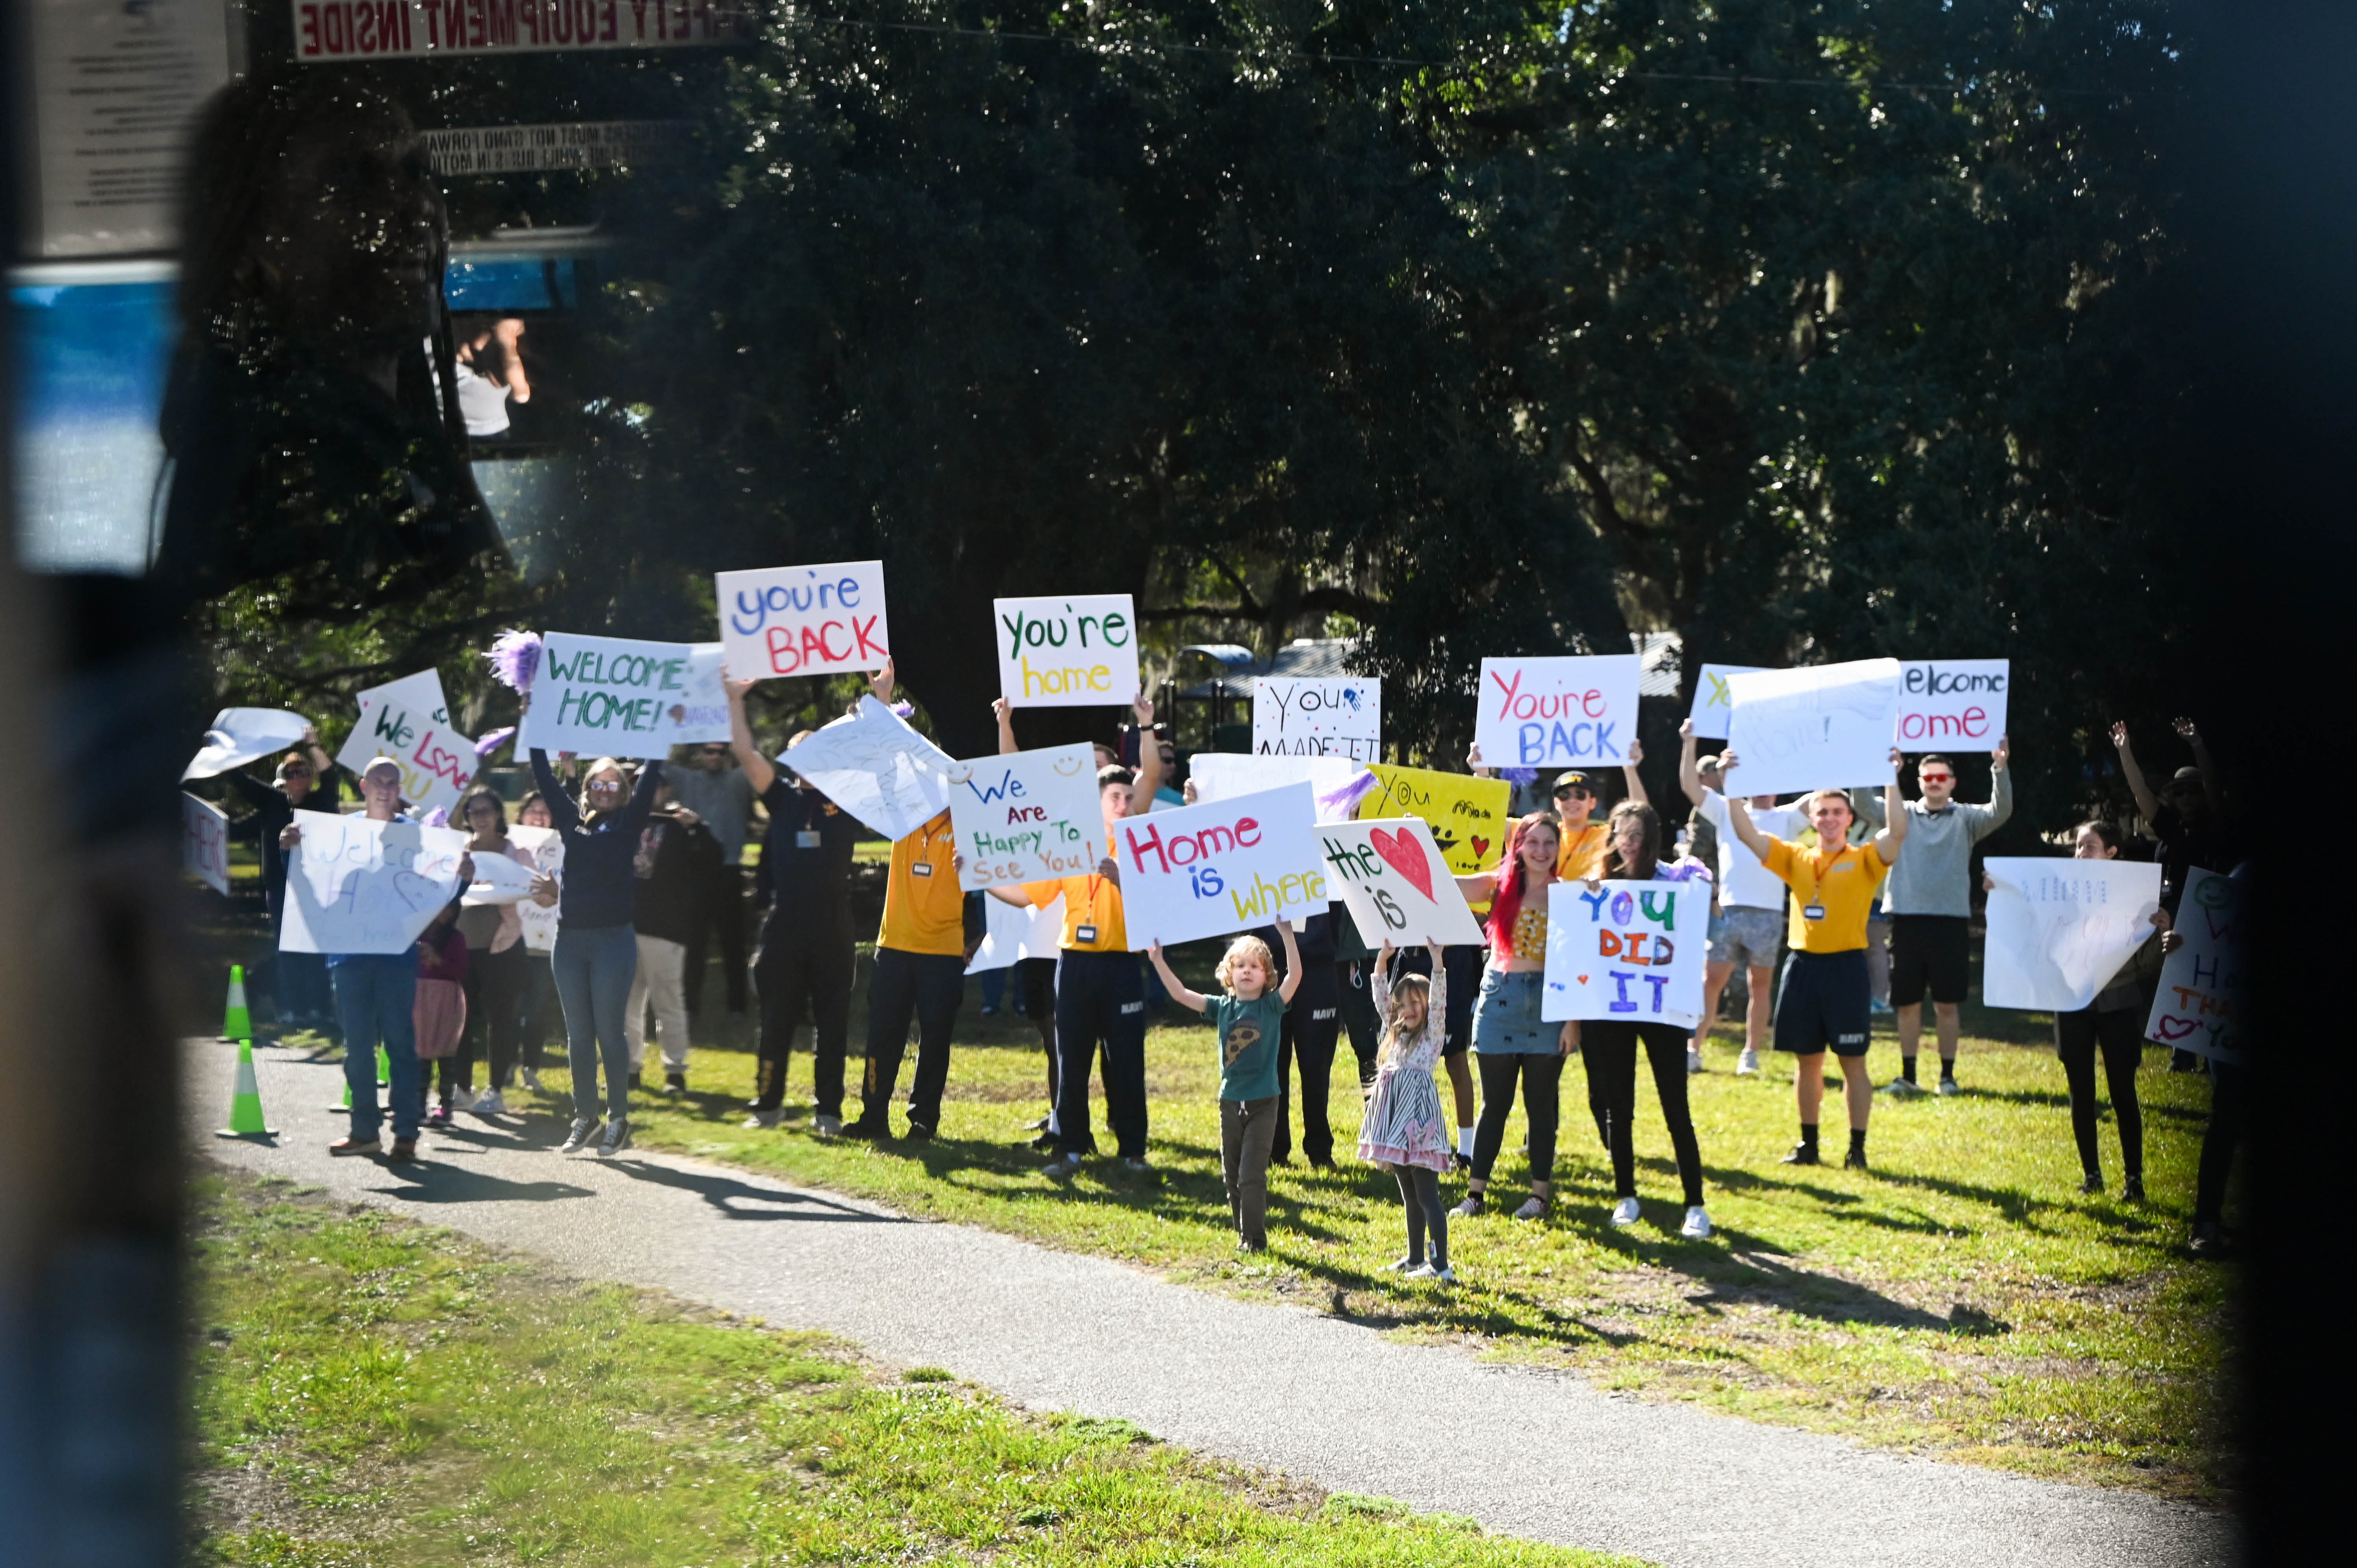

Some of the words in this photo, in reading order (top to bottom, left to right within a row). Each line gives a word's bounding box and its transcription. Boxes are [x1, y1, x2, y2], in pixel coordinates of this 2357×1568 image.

[766, 615, 888, 674] BACK
[548, 648, 688, 691] WELCOME
[1022, 654, 1112, 698] home
[1899, 664, 2008, 696] elcome
[375, 703, 414, 748] We
[557, 688, 665, 732] HOME!
[1897, 706, 1990, 742] ome
[1341, 737, 1379, 762] IT
[1519, 720, 1620, 765] BACK
[967, 768, 1027, 805] We
[1007, 806, 1047, 826] Are
[973, 829, 1043, 858] Happy
[1050, 819, 1081, 844] To
[1125, 817, 1262, 874] Home
[1323, 837, 1383, 881] the
[972, 860, 1025, 885] See
[1188, 865, 1224, 900] is
[1231, 870, 1327, 922] where
[1364, 885, 1407, 932] is
[1579, 887, 1676, 931] YOU
[1600, 929, 1674, 966] DID
[1609, 970, 1669, 1013] IT
[1312, 1007, 1336, 1020] NAVY
